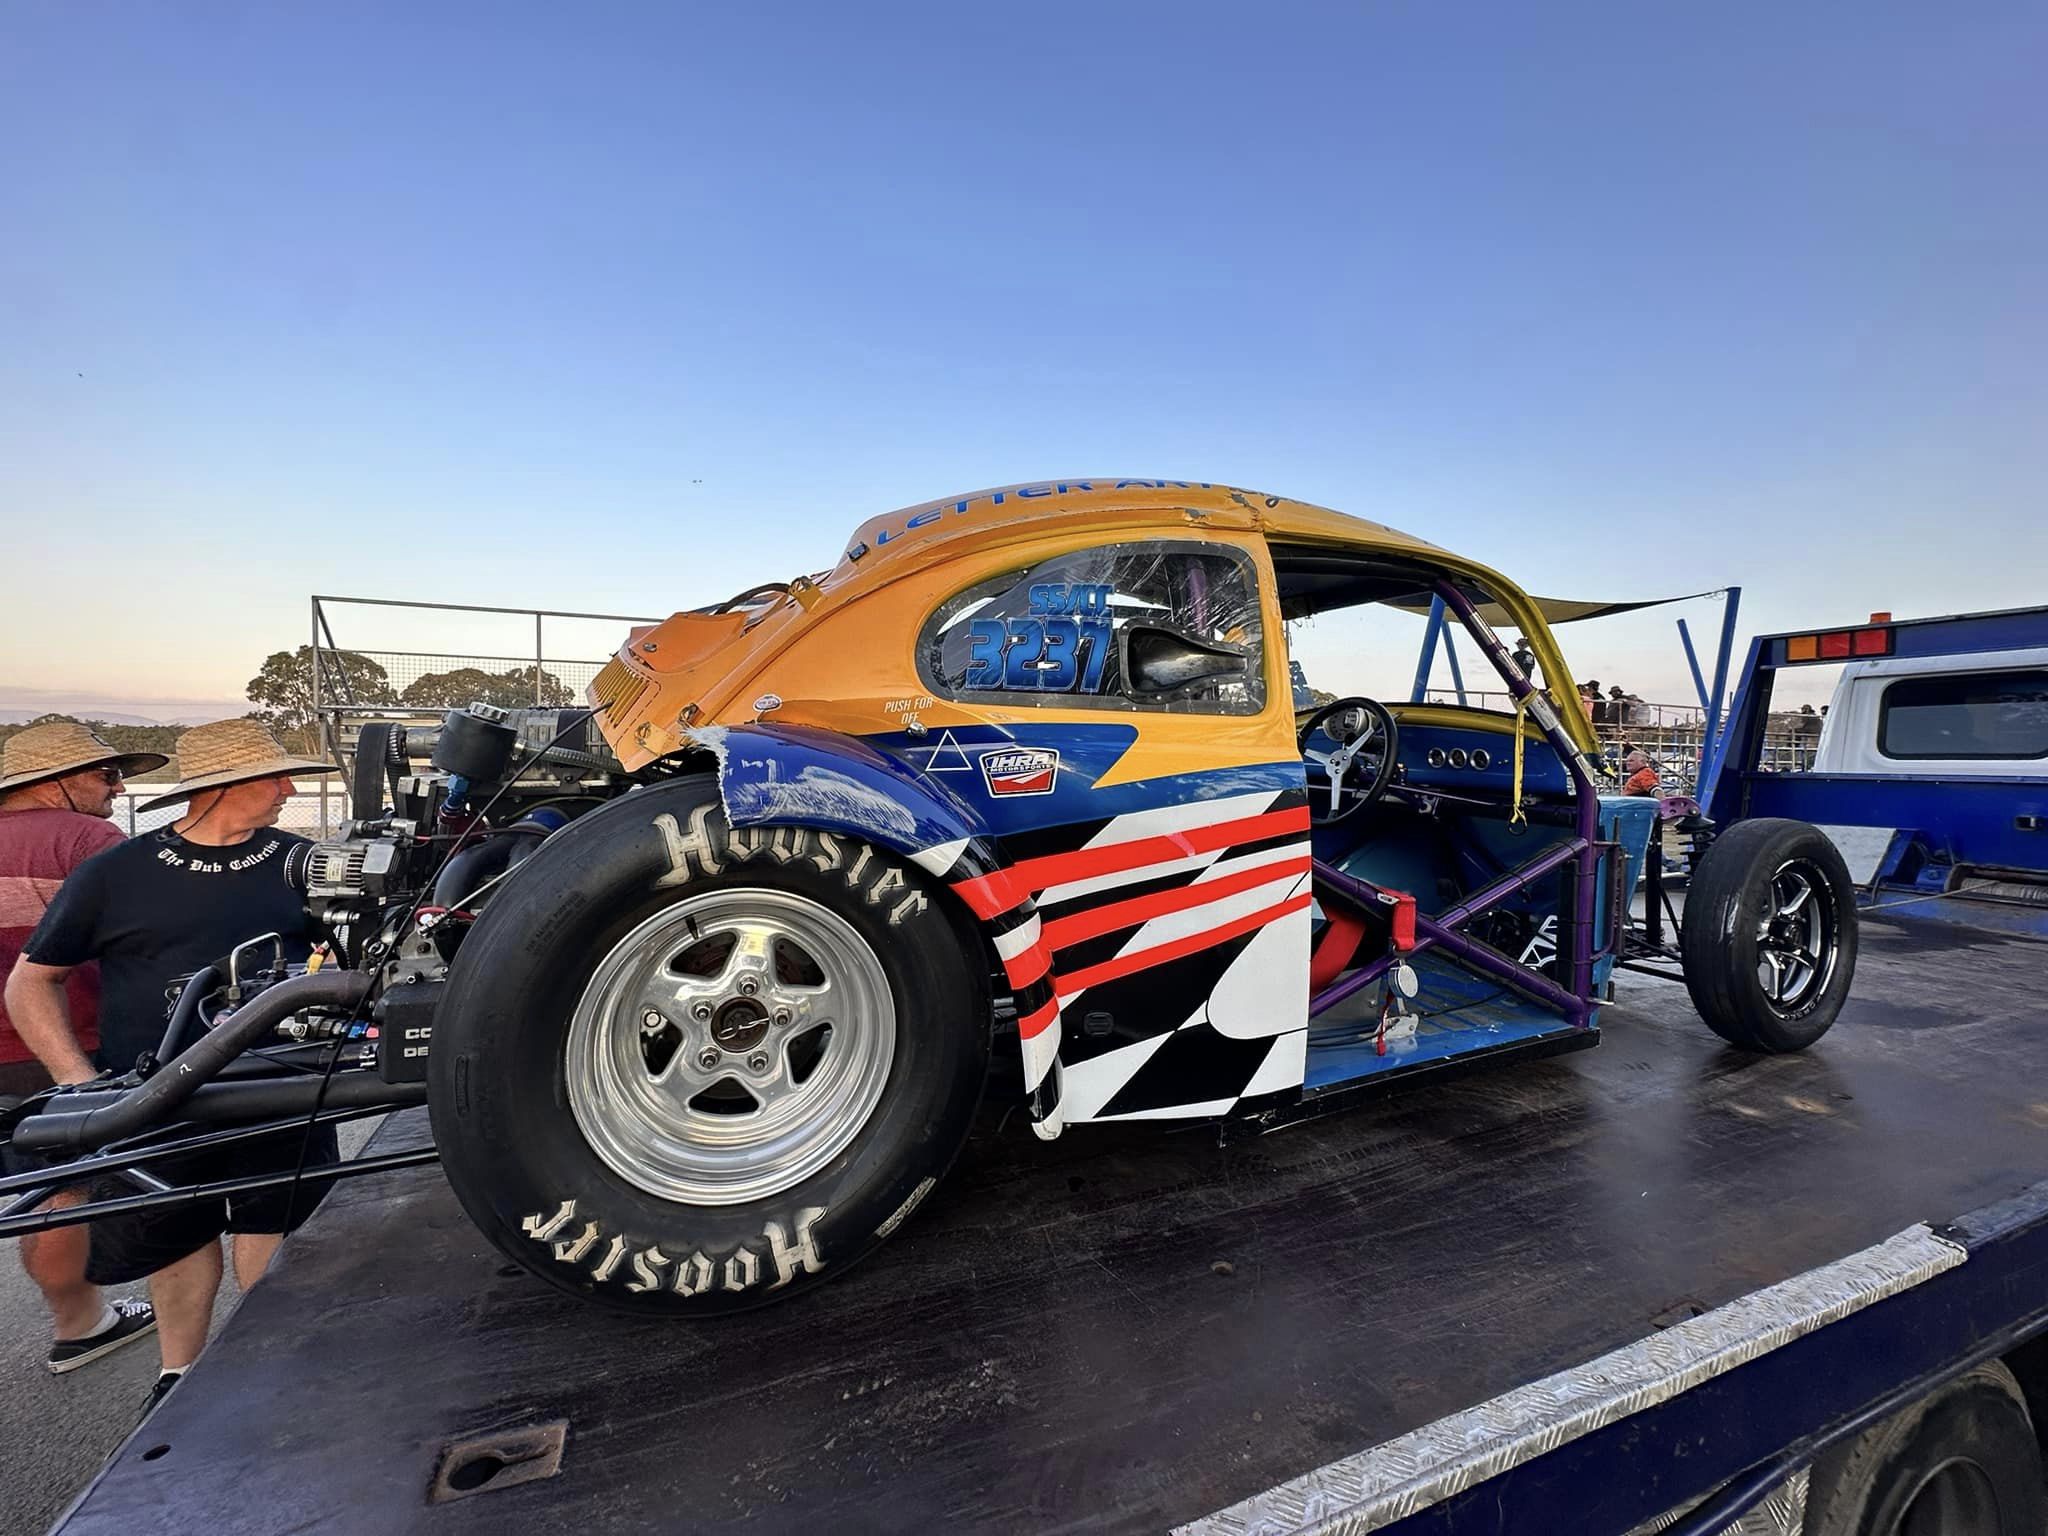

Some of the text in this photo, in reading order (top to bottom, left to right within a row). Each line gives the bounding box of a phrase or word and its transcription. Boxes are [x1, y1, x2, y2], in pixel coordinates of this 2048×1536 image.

[876, 481, 1093, 546] LETTER
[884, 696, 934, 713] PUSH FOR
[901, 711, 920, 725] OFF
[990, 754, 1051, 768] IHRA
[158, 848, 185, 867] The
[188, 859, 223, 873] Dub
